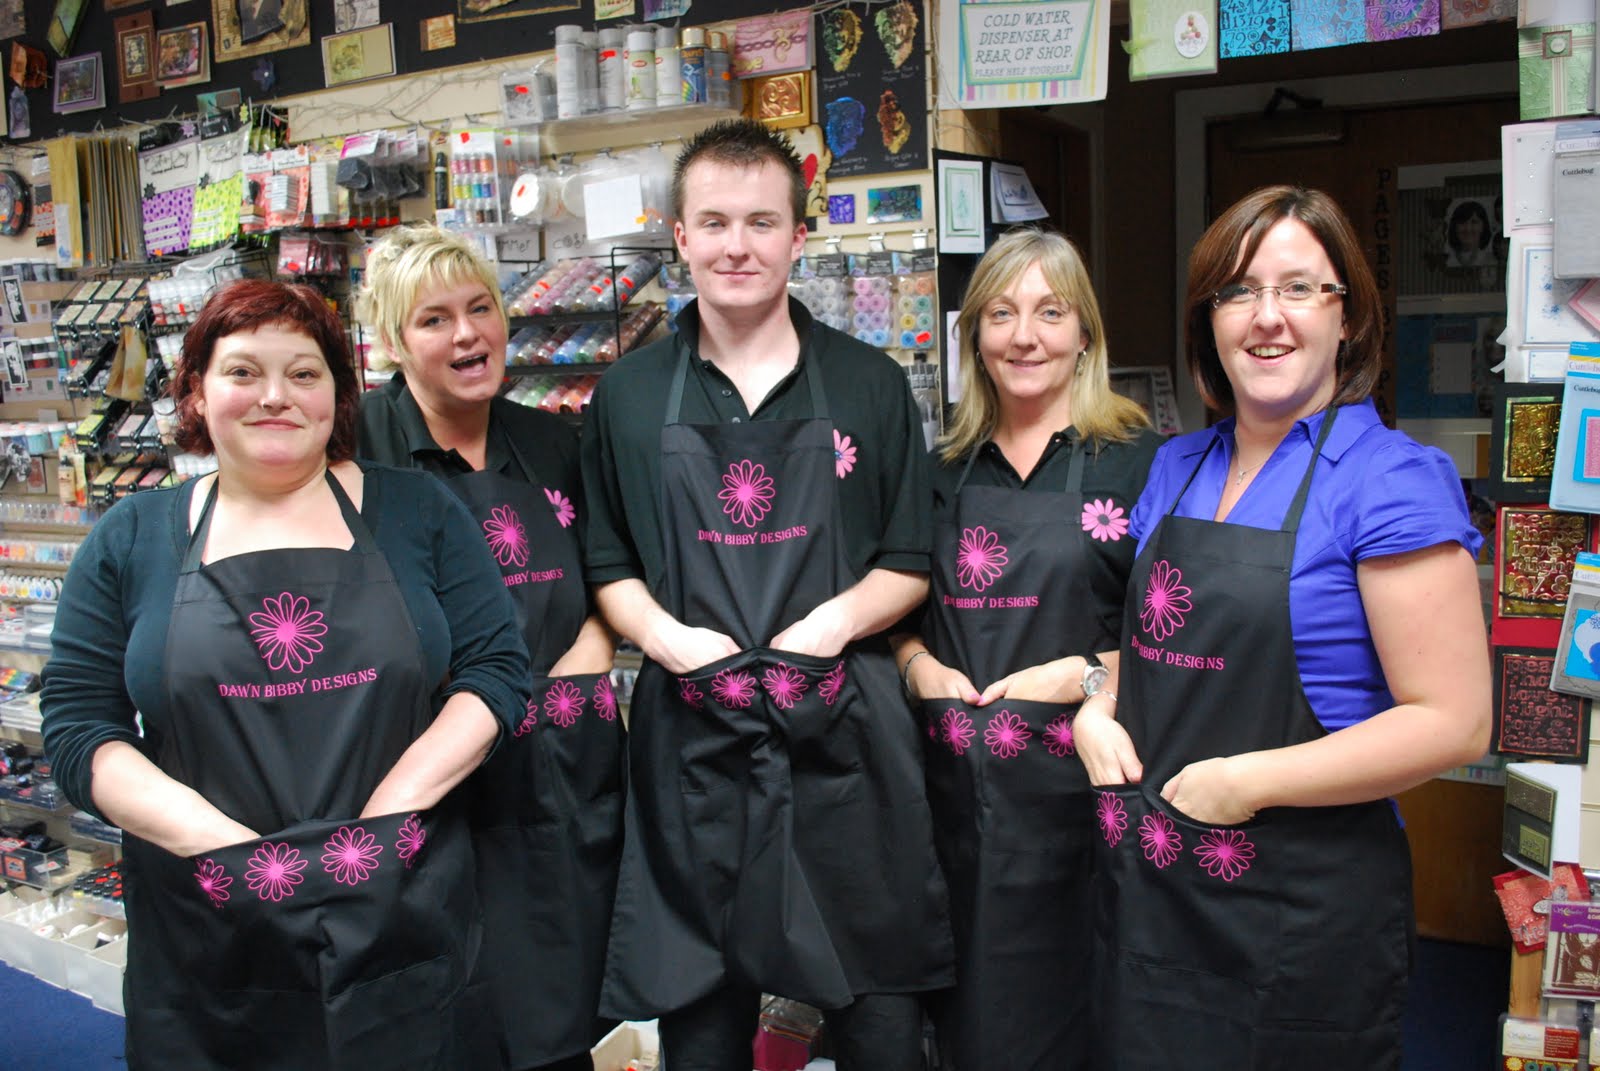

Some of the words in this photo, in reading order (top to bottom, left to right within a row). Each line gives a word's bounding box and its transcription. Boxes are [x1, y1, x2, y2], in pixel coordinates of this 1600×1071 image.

[983, 13, 1021, 28] COLD
[1024, 10, 1071, 26] WATER
[979, 29, 1050, 46] DISPENSER
[1052, 27, 1073, 42] AT
[975, 49, 1012, 64] REAR
[1014, 47, 1034, 61] OF
[1036, 45, 1073, 60] SHOP.
[975, 67, 1004, 78] PLEASE
[1006, 65, 1026, 76] HELP
[724, 531, 758, 545] BIBBY
[760, 525, 808, 544] DESIGNS
[502, 570, 530, 587] IBBY
[989, 595, 1039, 608] DESIGNS
[1165, 651, 1225, 671] DESIGNS
[218, 683, 261, 698] DAWN
[264, 678, 308, 698] BIBBY
[311, 668, 378, 693] DESIGNS
